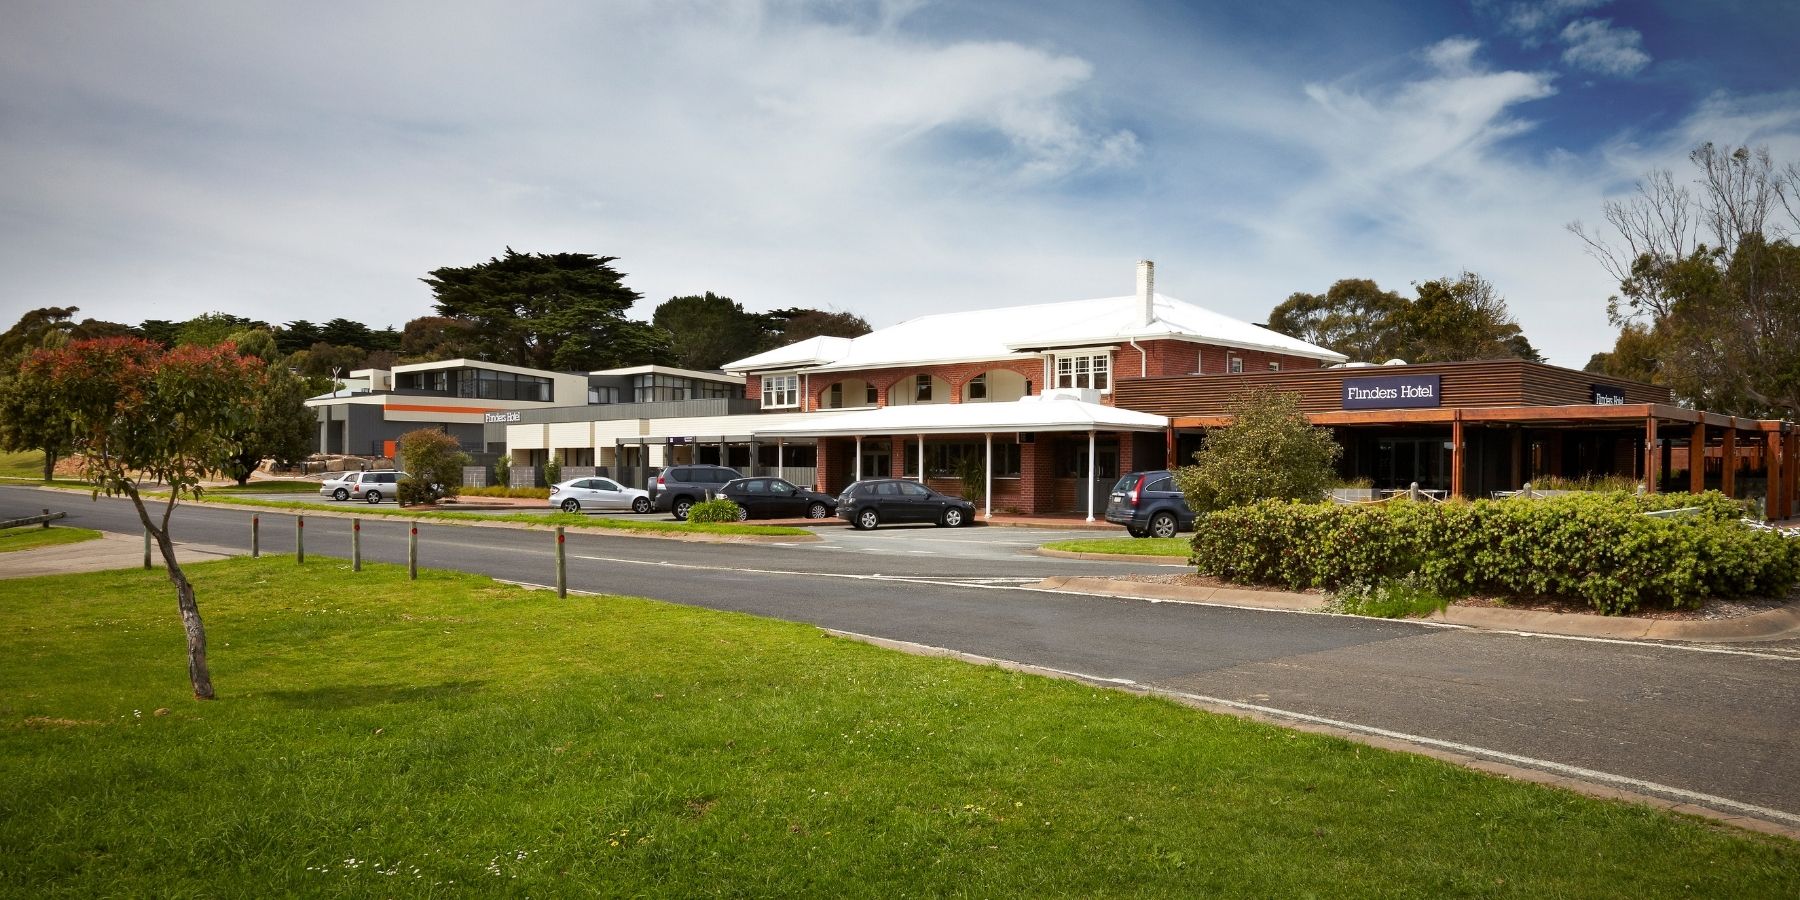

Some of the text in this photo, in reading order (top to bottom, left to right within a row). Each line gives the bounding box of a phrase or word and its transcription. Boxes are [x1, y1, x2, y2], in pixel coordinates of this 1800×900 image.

[1348, 385, 1433, 399] Flinders Hotel
[506, 411, 520, 422] Hotel
